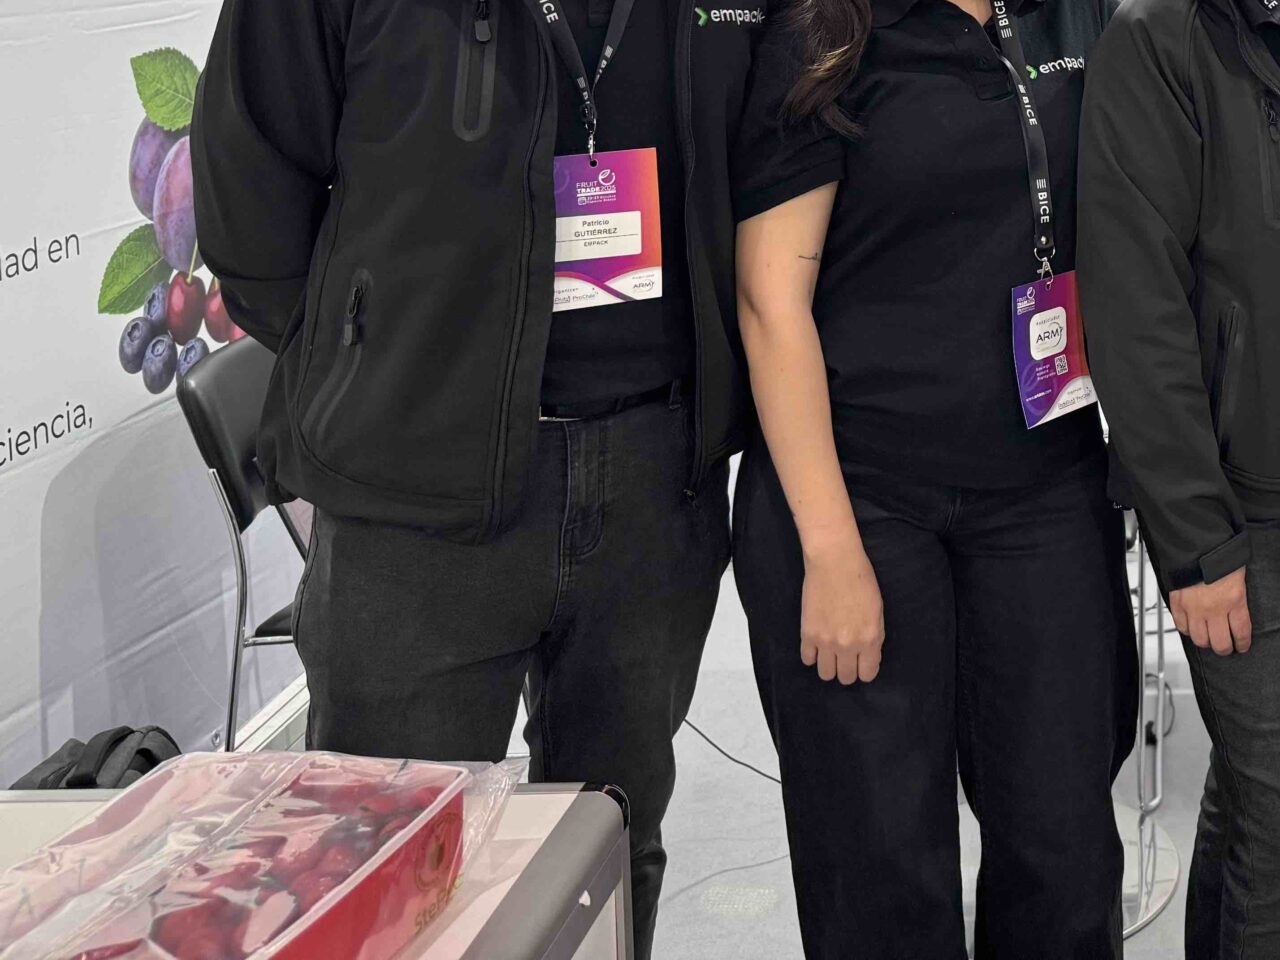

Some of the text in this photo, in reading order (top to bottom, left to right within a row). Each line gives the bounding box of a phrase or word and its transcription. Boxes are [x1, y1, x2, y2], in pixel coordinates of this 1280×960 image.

[710, 7, 765, 25] empack
[994, 0, 1009, 27] BICE
[1022, 97, 1037, 126] BICE
[1038, 191, 1050, 224] BICE
[0, 233, 80, 281] ad en
